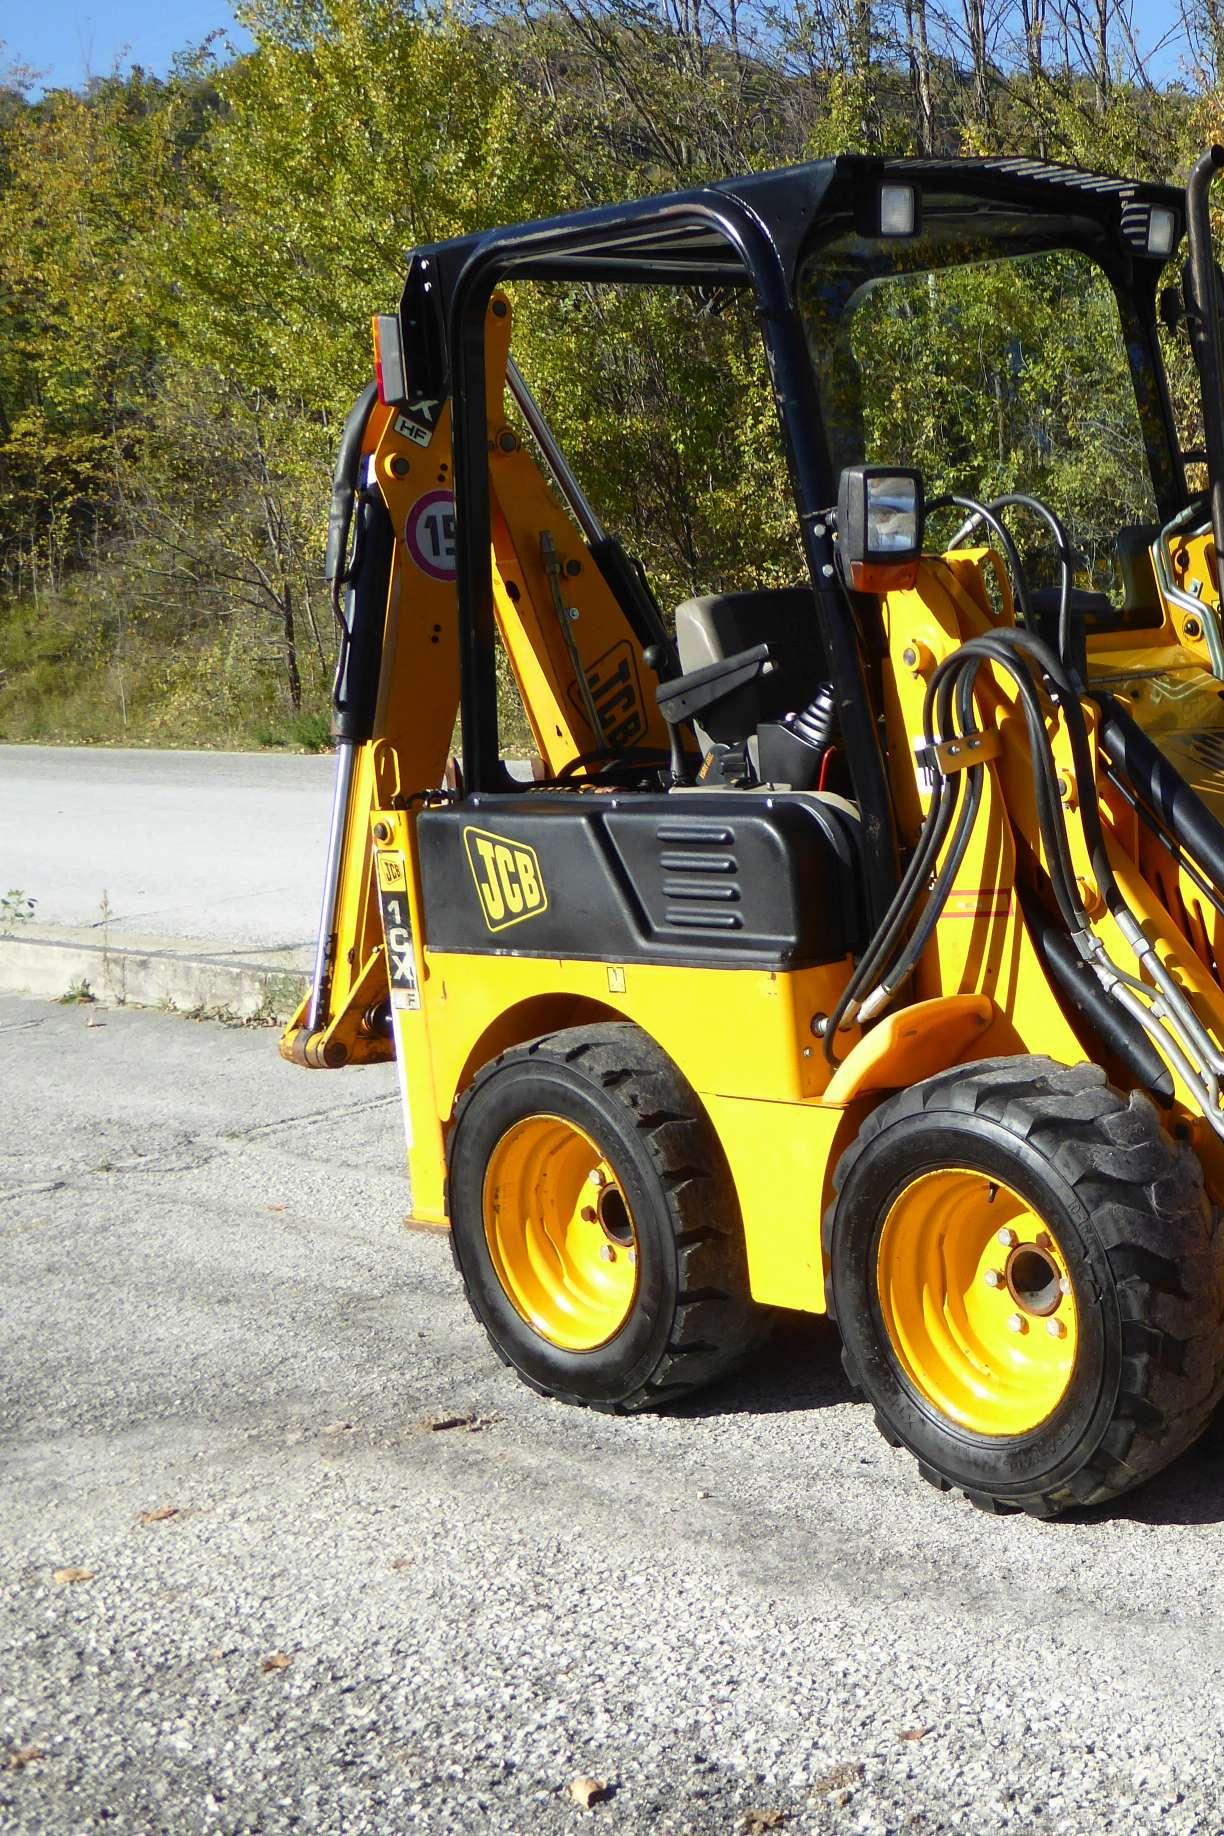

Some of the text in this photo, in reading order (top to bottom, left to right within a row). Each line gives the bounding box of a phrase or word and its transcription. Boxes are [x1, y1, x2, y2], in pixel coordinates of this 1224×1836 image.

[399, 420, 427, 440] HF
[384, 861, 401, 882] JCB
[475, 837, 541, 920] JCB
[387, 900, 415, 980] 1CX
